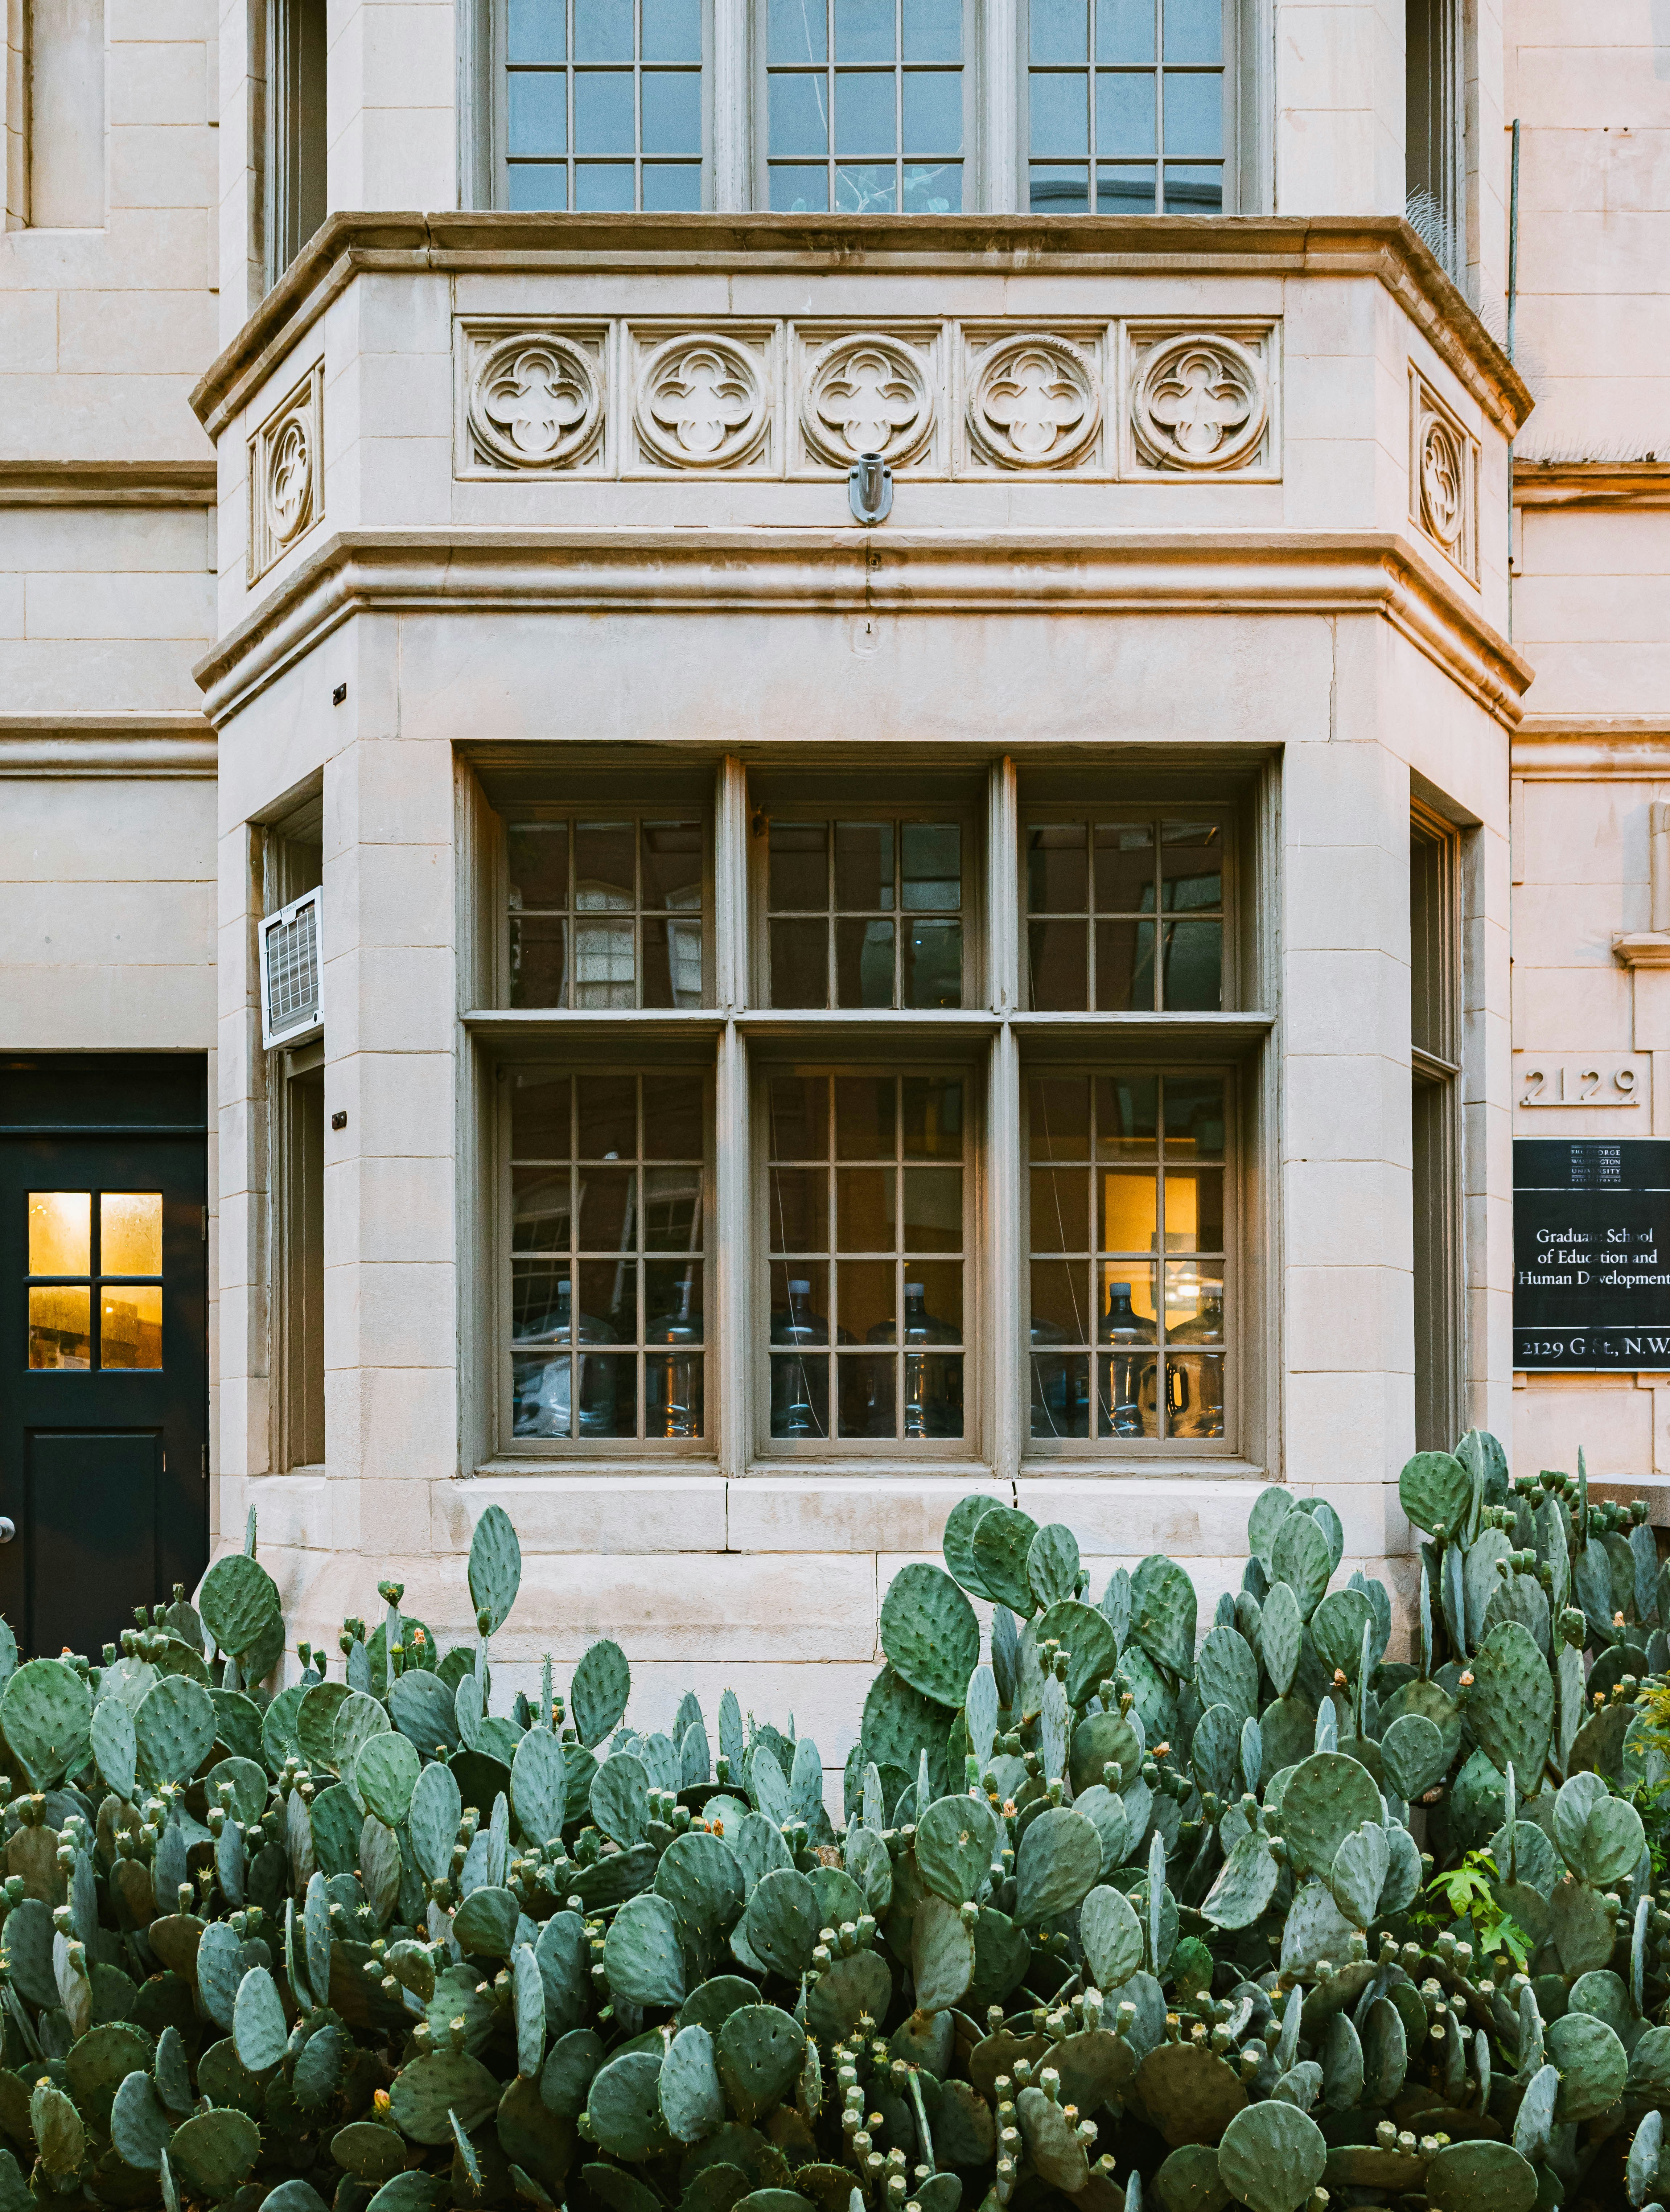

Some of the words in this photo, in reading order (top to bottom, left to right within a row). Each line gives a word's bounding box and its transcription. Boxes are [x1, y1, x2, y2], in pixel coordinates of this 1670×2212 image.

[1524, 1068, 1639, 1102] 2129
[1607, 1228, 1653, 1243] Schol
[1538, 1249, 1555, 1263] of
[1558, 1249, 1629, 1264] Eduction
[1632, 1249, 1658, 1263] and
[1518, 1271, 1572, 1284] Human
[1522, 1342, 1564, 1358] 2129
[1570, 1338, 1587, 1354] G
